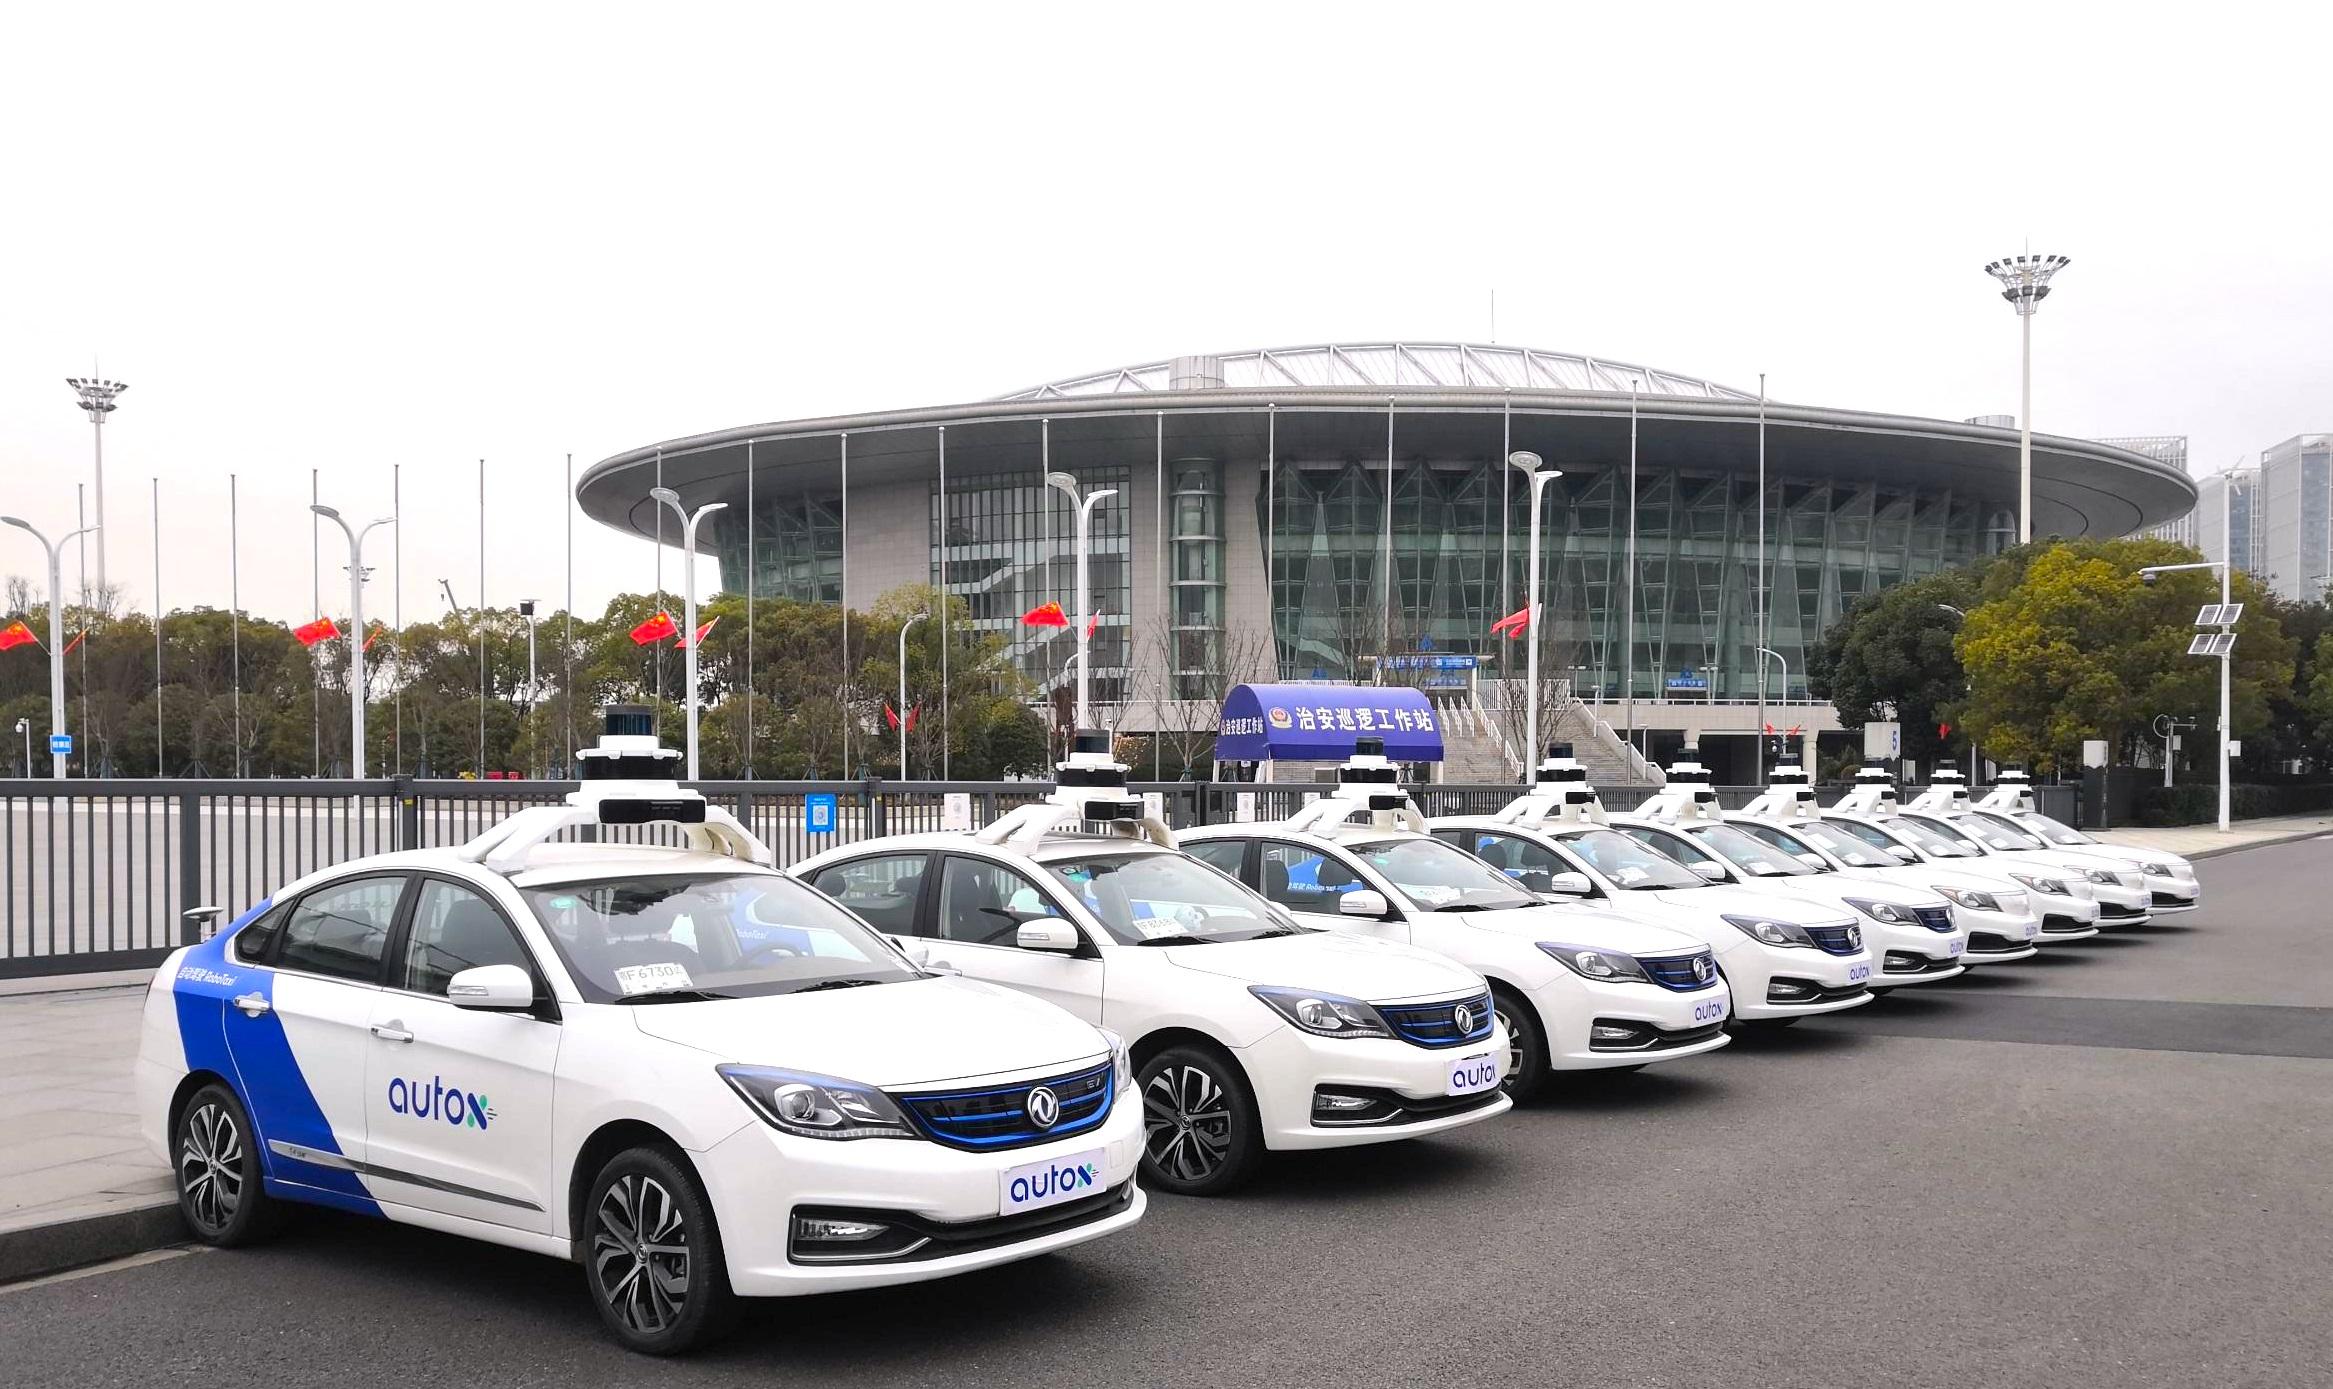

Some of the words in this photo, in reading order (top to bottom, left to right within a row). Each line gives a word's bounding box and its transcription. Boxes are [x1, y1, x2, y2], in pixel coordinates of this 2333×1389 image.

[1225, 717, 1264, 736] 治安巡逻工作站
[1296, 706, 1435, 733] 治安巡逻工作站
[1892, 730, 1898, 751] 5
